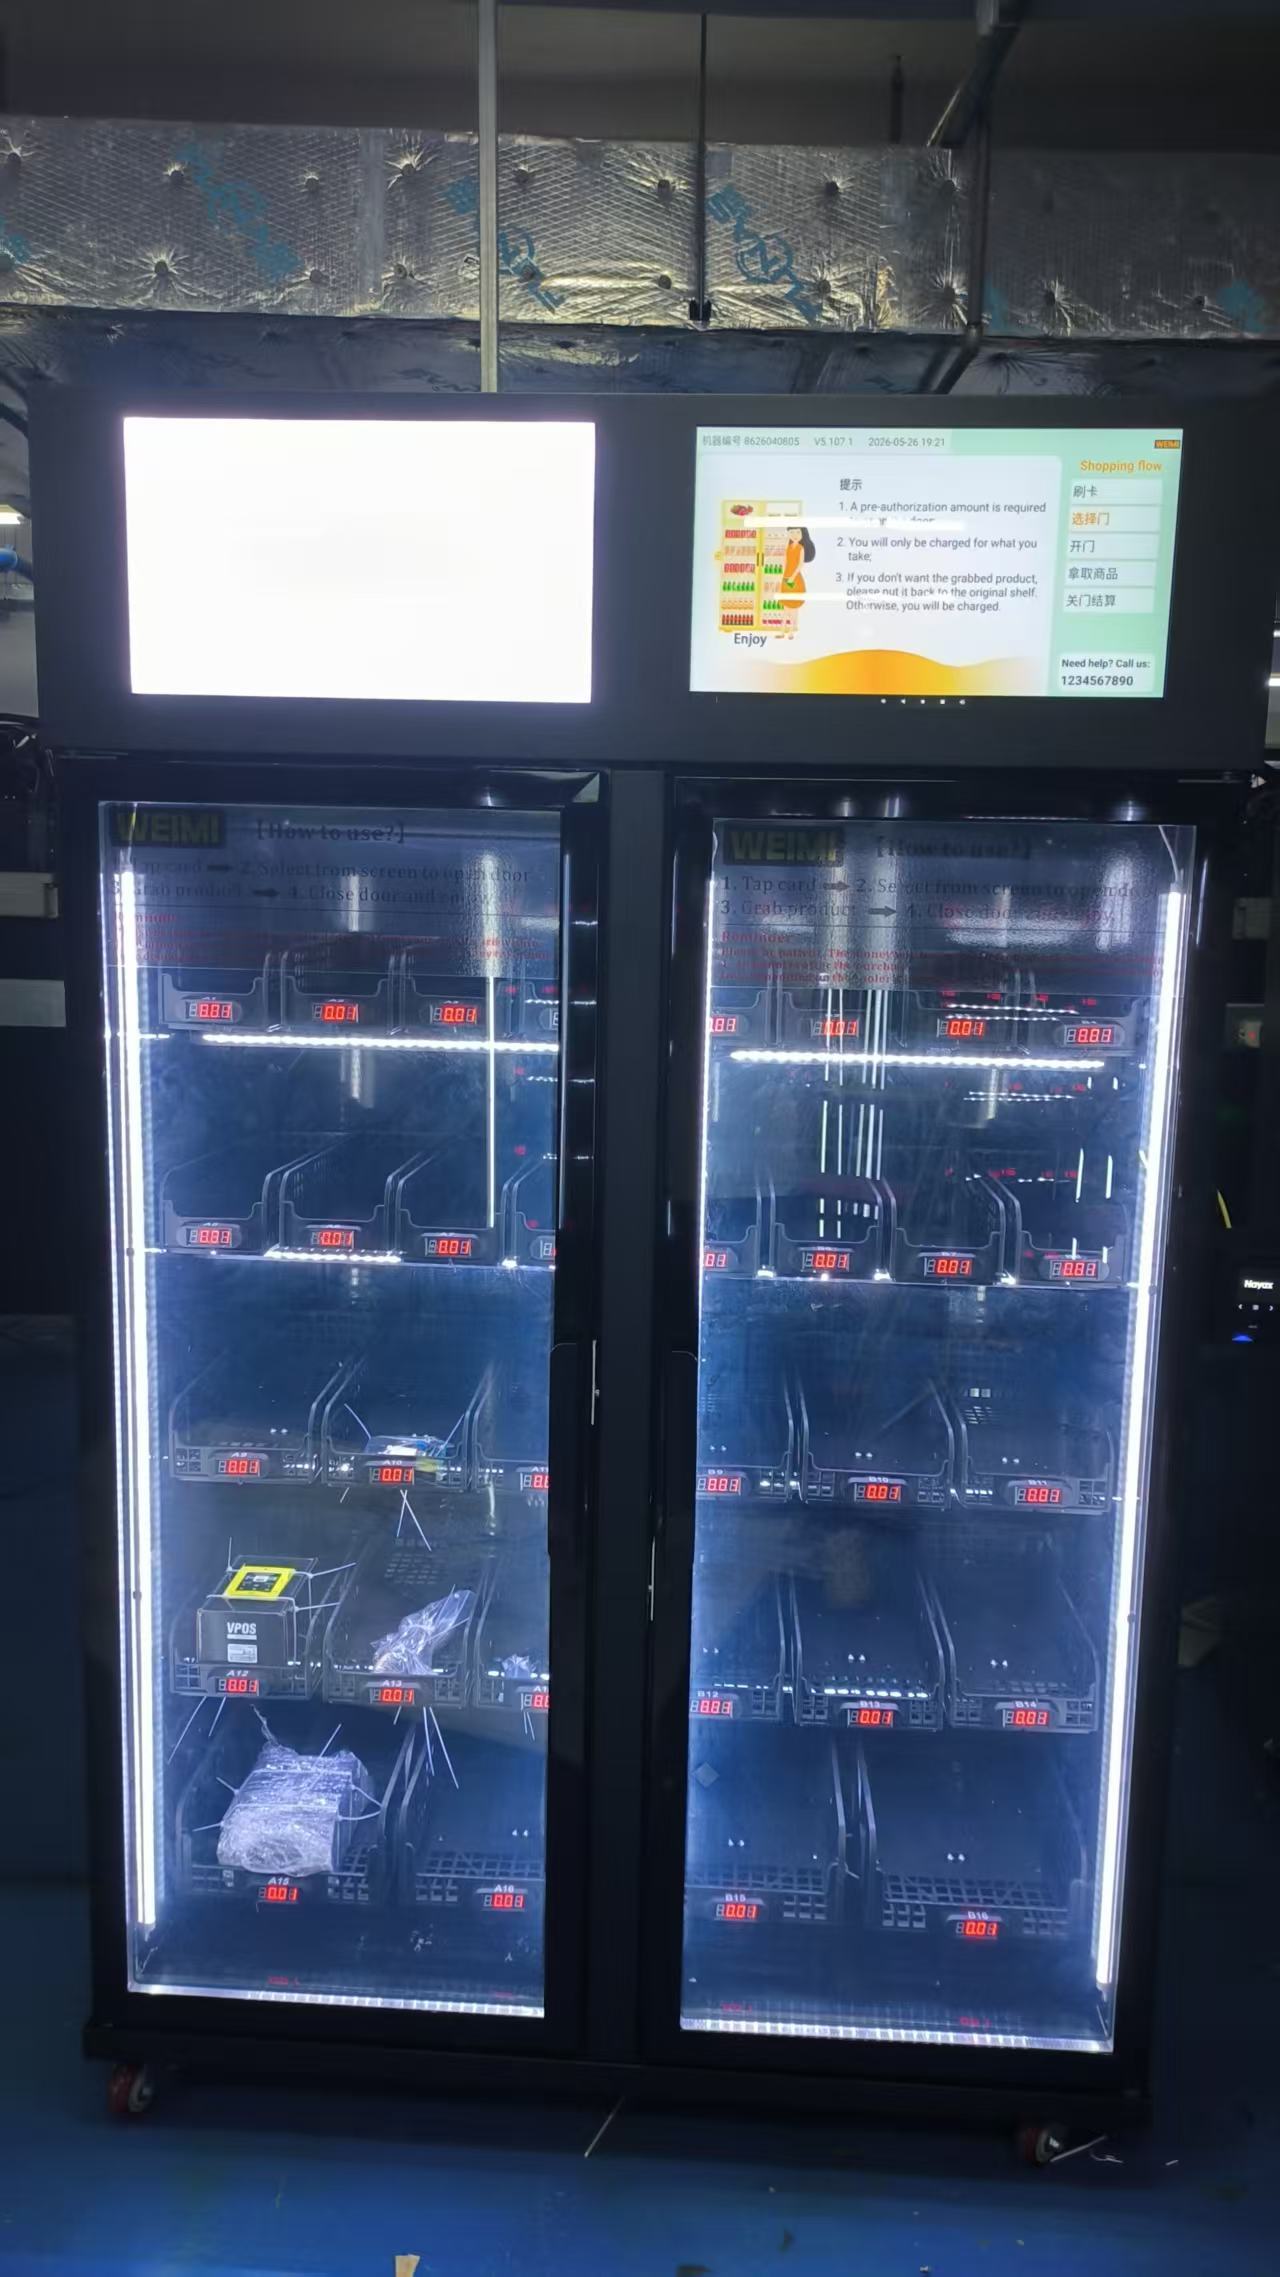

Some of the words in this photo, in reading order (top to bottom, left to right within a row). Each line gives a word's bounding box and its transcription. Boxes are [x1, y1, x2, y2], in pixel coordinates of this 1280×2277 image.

[744, 436, 800, 447] 8626040805
[868, 437, 919, 447] 2026-05-26
[921, 437, 946, 447] 19:21
[1080, 460, 1135, 474] Shopping
[1138, 459, 1163, 471] flow
[839, 478, 863, 491] 提示
[1073, 485, 1099, 498] 刷卡
[839, 502, 848, 511] 1.
[850, 502, 858, 511] A
[860, 502, 948, 514] pre-authorization
[950, 502, 990, 512] amount
[992, 502, 1001, 512] is
[1003, 502, 1047, 514] required
[1072, 512, 1110, 526] 选择门
[849, 537, 868, 547] You
[871, 537, 889, 547] will
[890, 537, 911, 550] only
[914, 538, 927, 548] be
[929, 538, 971, 550] charged
[973, 538, 988, 548] for
[990, 538, 1016, 548] what
[1018, 540, 1038, 551] you
[1070, 540, 1096, 553] 开门
[848, 573, 855, 583] If
[857, 575, 876, 585] you
[878, 573, 901, 583] don't
[904, 574, 930, 583] want
[932, 573, 949, 583] the
[951, 573, 993, 585] grabbed
[995, 574, 1038, 586] product,
[1068, 566, 1119, 580] 拿取商品
[901, 587, 908, 597] it
[950, 587, 967, 598] the
[969, 587, 1008, 599] original
[1009, 587, 1038, 598] shelf.
[846, 600, 900, 612] Otherwise,
[901, 603, 920, 613] you
[922, 601, 940, 611] will
[942, 601, 955, 611] be
[957, 601, 1000, 613] charged.
[1065, 594, 1116, 607] 关门结算
[733, 632, 768, 647] Enjoy
[1061, 659, 1086, 668] Need
[1088, 659, 1113, 670] help?
[1115, 659, 1134, 668] Call
[1136, 660, 1151, 668] us:
[1061, 675, 1134, 686] 1234567890
[115, 813, 221, 843] WEIMI
[729, 831, 839, 861] WEIMI
[361, 864, 417, 879] screen
[723, 876, 737, 890] 1.
[742, 876, 773, 894] Tap
[777, 876, 816, 891] card
[720, 900, 737, 915] 3.
[226, 1622, 257, 1634] VPOS
